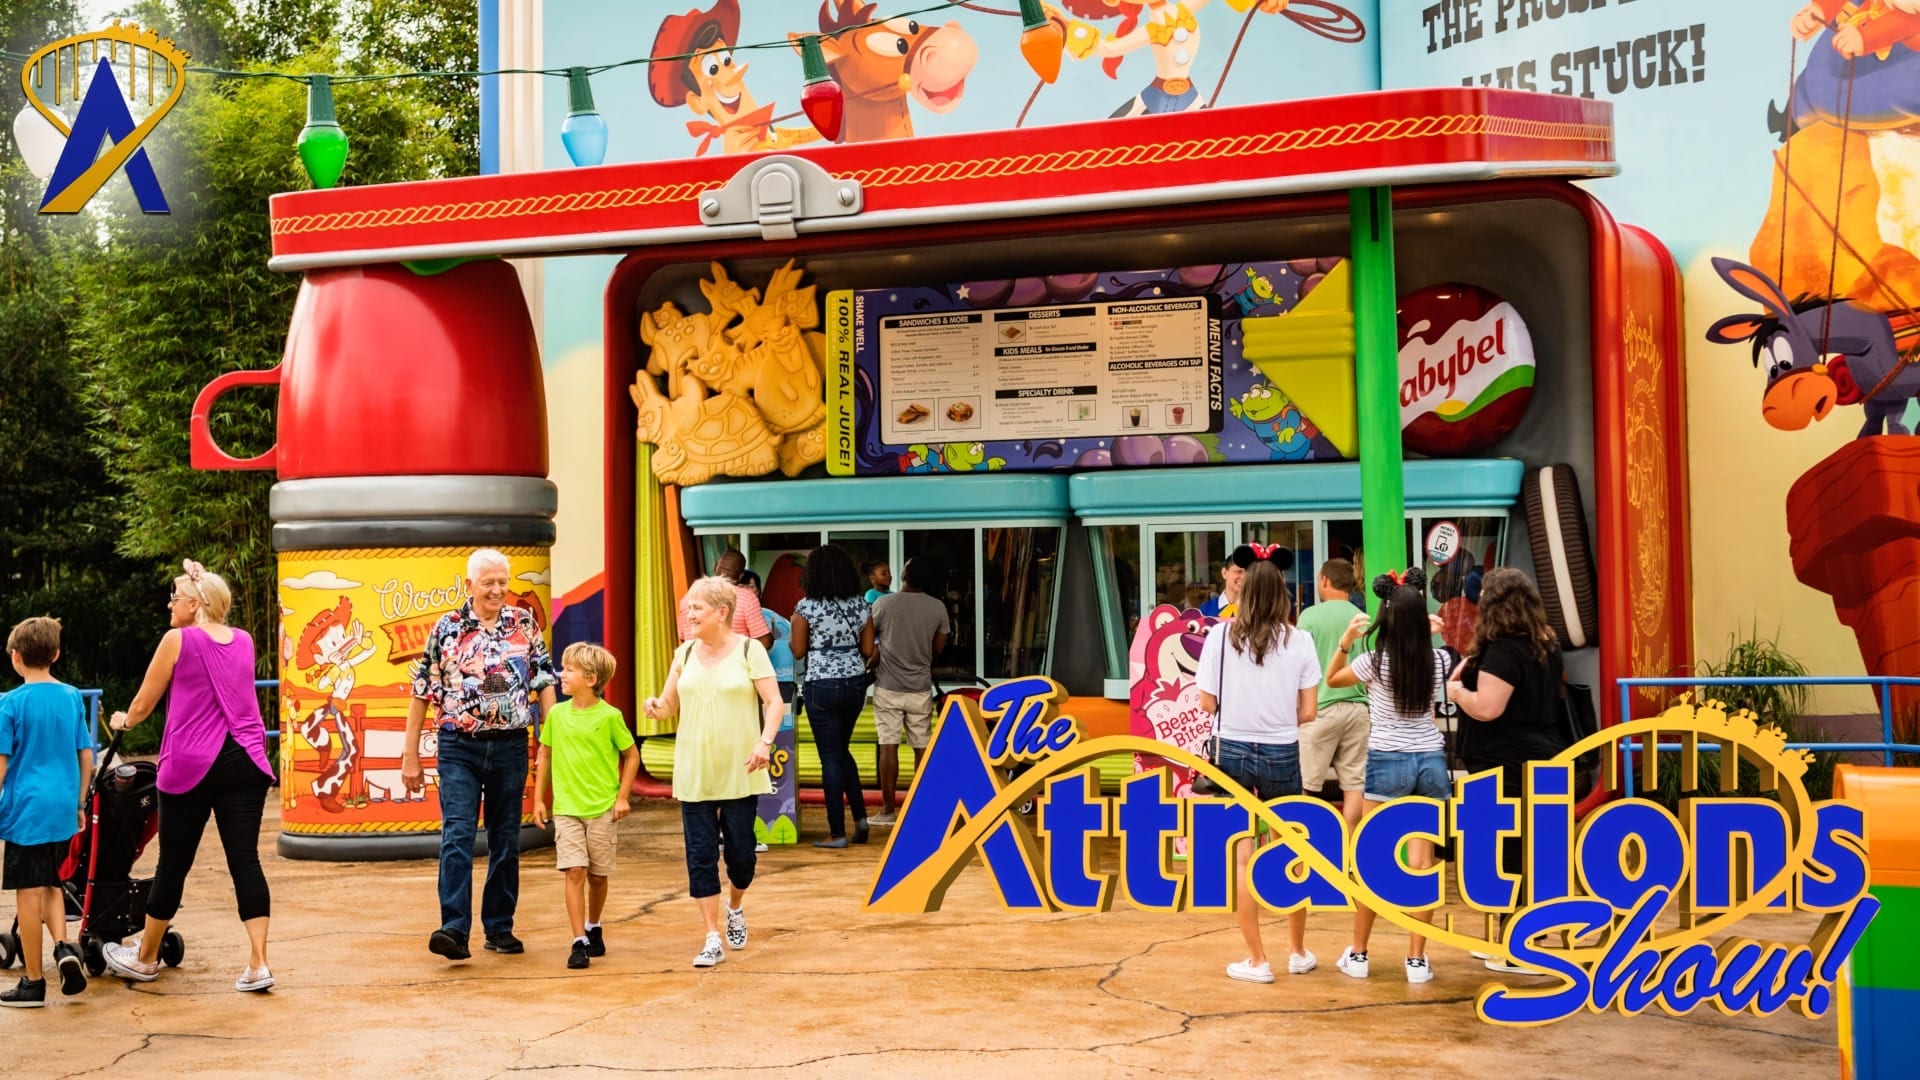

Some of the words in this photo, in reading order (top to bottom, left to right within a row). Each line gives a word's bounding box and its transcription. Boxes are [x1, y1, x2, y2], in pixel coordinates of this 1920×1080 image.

[1422, 0, 1483, 54] THE
[1462, 60, 1537, 93] AS
[1551, 23, 1706, 98] STUCK!
[838, 296, 850, 344] 100%
[856, 296, 864, 326] SHAKE
[899, 318, 941, 327] SANDWICHES
[1028, 310, 1060, 318] DESSERTS
[1112, 304, 1163, 314] NON-ALCOHOLIC
[1164, 302, 1198, 310] BEVERAGES
[856, 328, 864, 354] WELL
[1003, 347, 1018, 355] KIDS
[1020, 346, 1042, 354] MEALS
[1209, 318, 1221, 362] MENU
[840, 350, 850, 400] REAL
[1110, 362, 1144, 370] ALCOHOLIC
[1400, 316, 1506, 408] abybel
[1018, 388, 1051, 397] SPECIALTY
[1053, 388, 1074, 396] DRINK
[1210, 365, 1222, 410] FACTS
[840, 405, 850, 468] JUICE!
[1173, 720, 1211, 747] Bites
